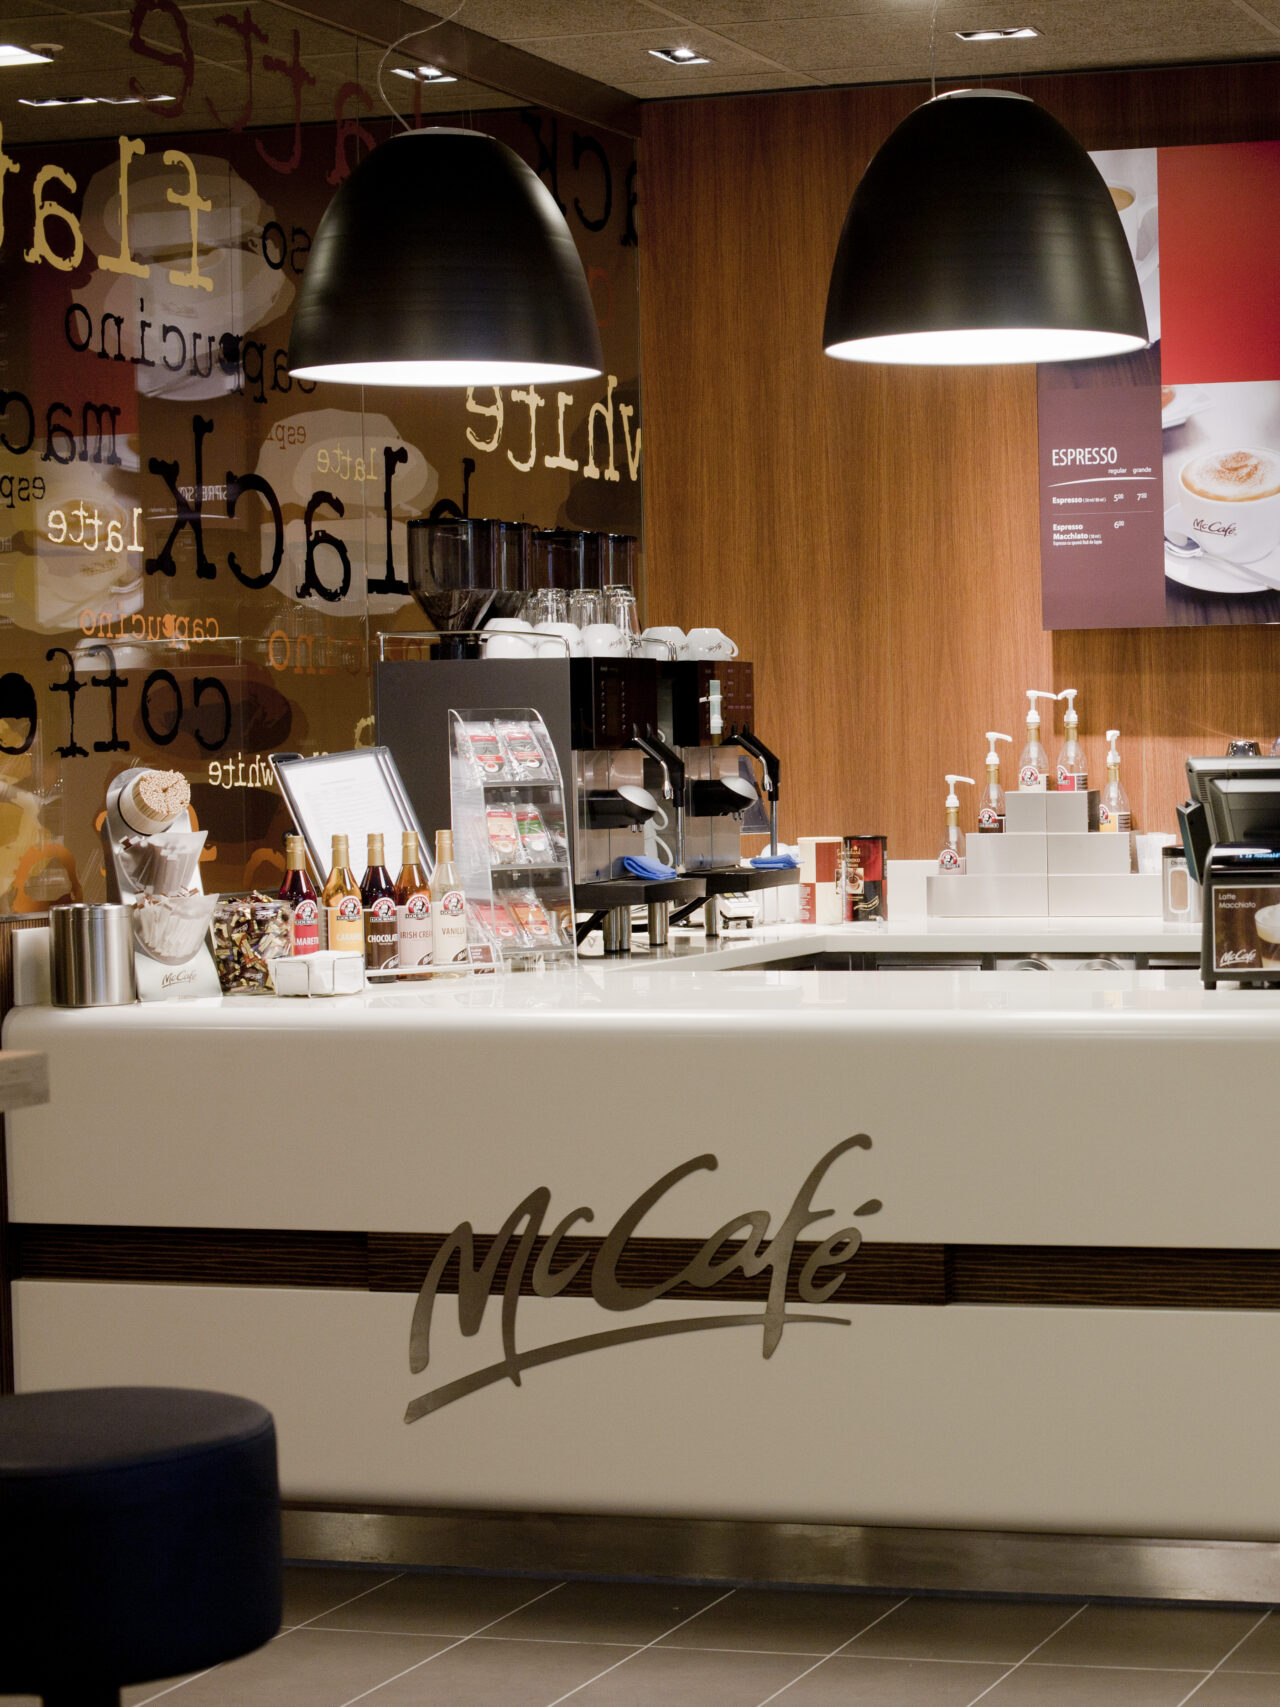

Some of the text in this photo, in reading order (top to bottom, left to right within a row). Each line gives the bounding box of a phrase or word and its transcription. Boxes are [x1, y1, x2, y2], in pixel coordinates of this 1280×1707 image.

[1052, 447, 1117, 466] ESPRESSO
[1052, 497, 1084, 505] Espresso
[1053, 524, 1083, 532] Espresso
[404, 1133, 883, 1424] McCafé
